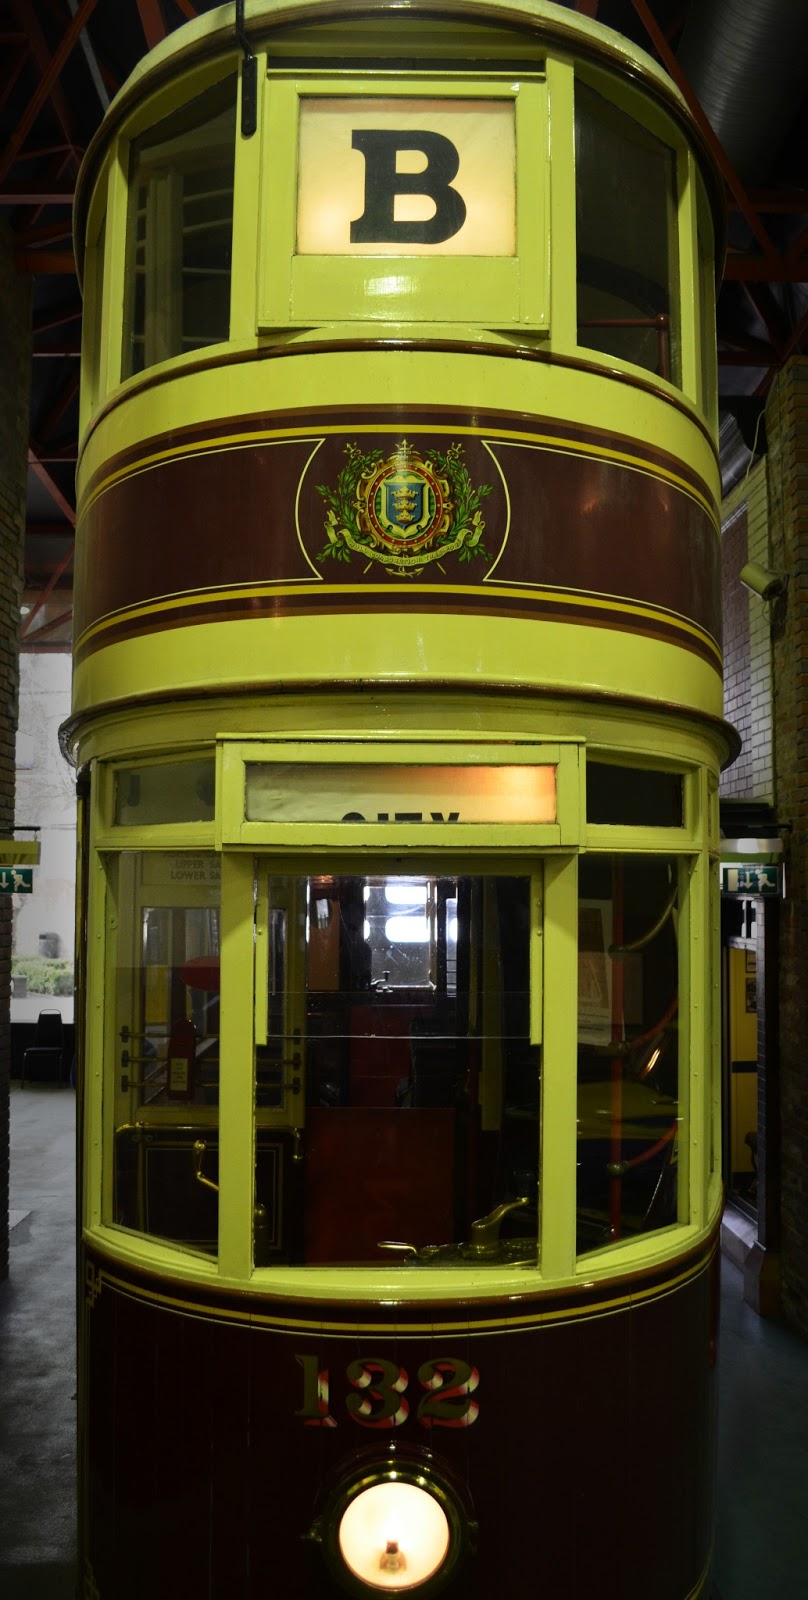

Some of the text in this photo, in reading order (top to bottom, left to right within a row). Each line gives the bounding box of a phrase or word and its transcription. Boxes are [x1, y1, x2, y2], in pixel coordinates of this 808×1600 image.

[350, 129, 467, 245] B
[170, 870, 206, 880] LOWER
[175, 859, 204, 869] UPPER
[294, 1354, 480, 1429] 132
